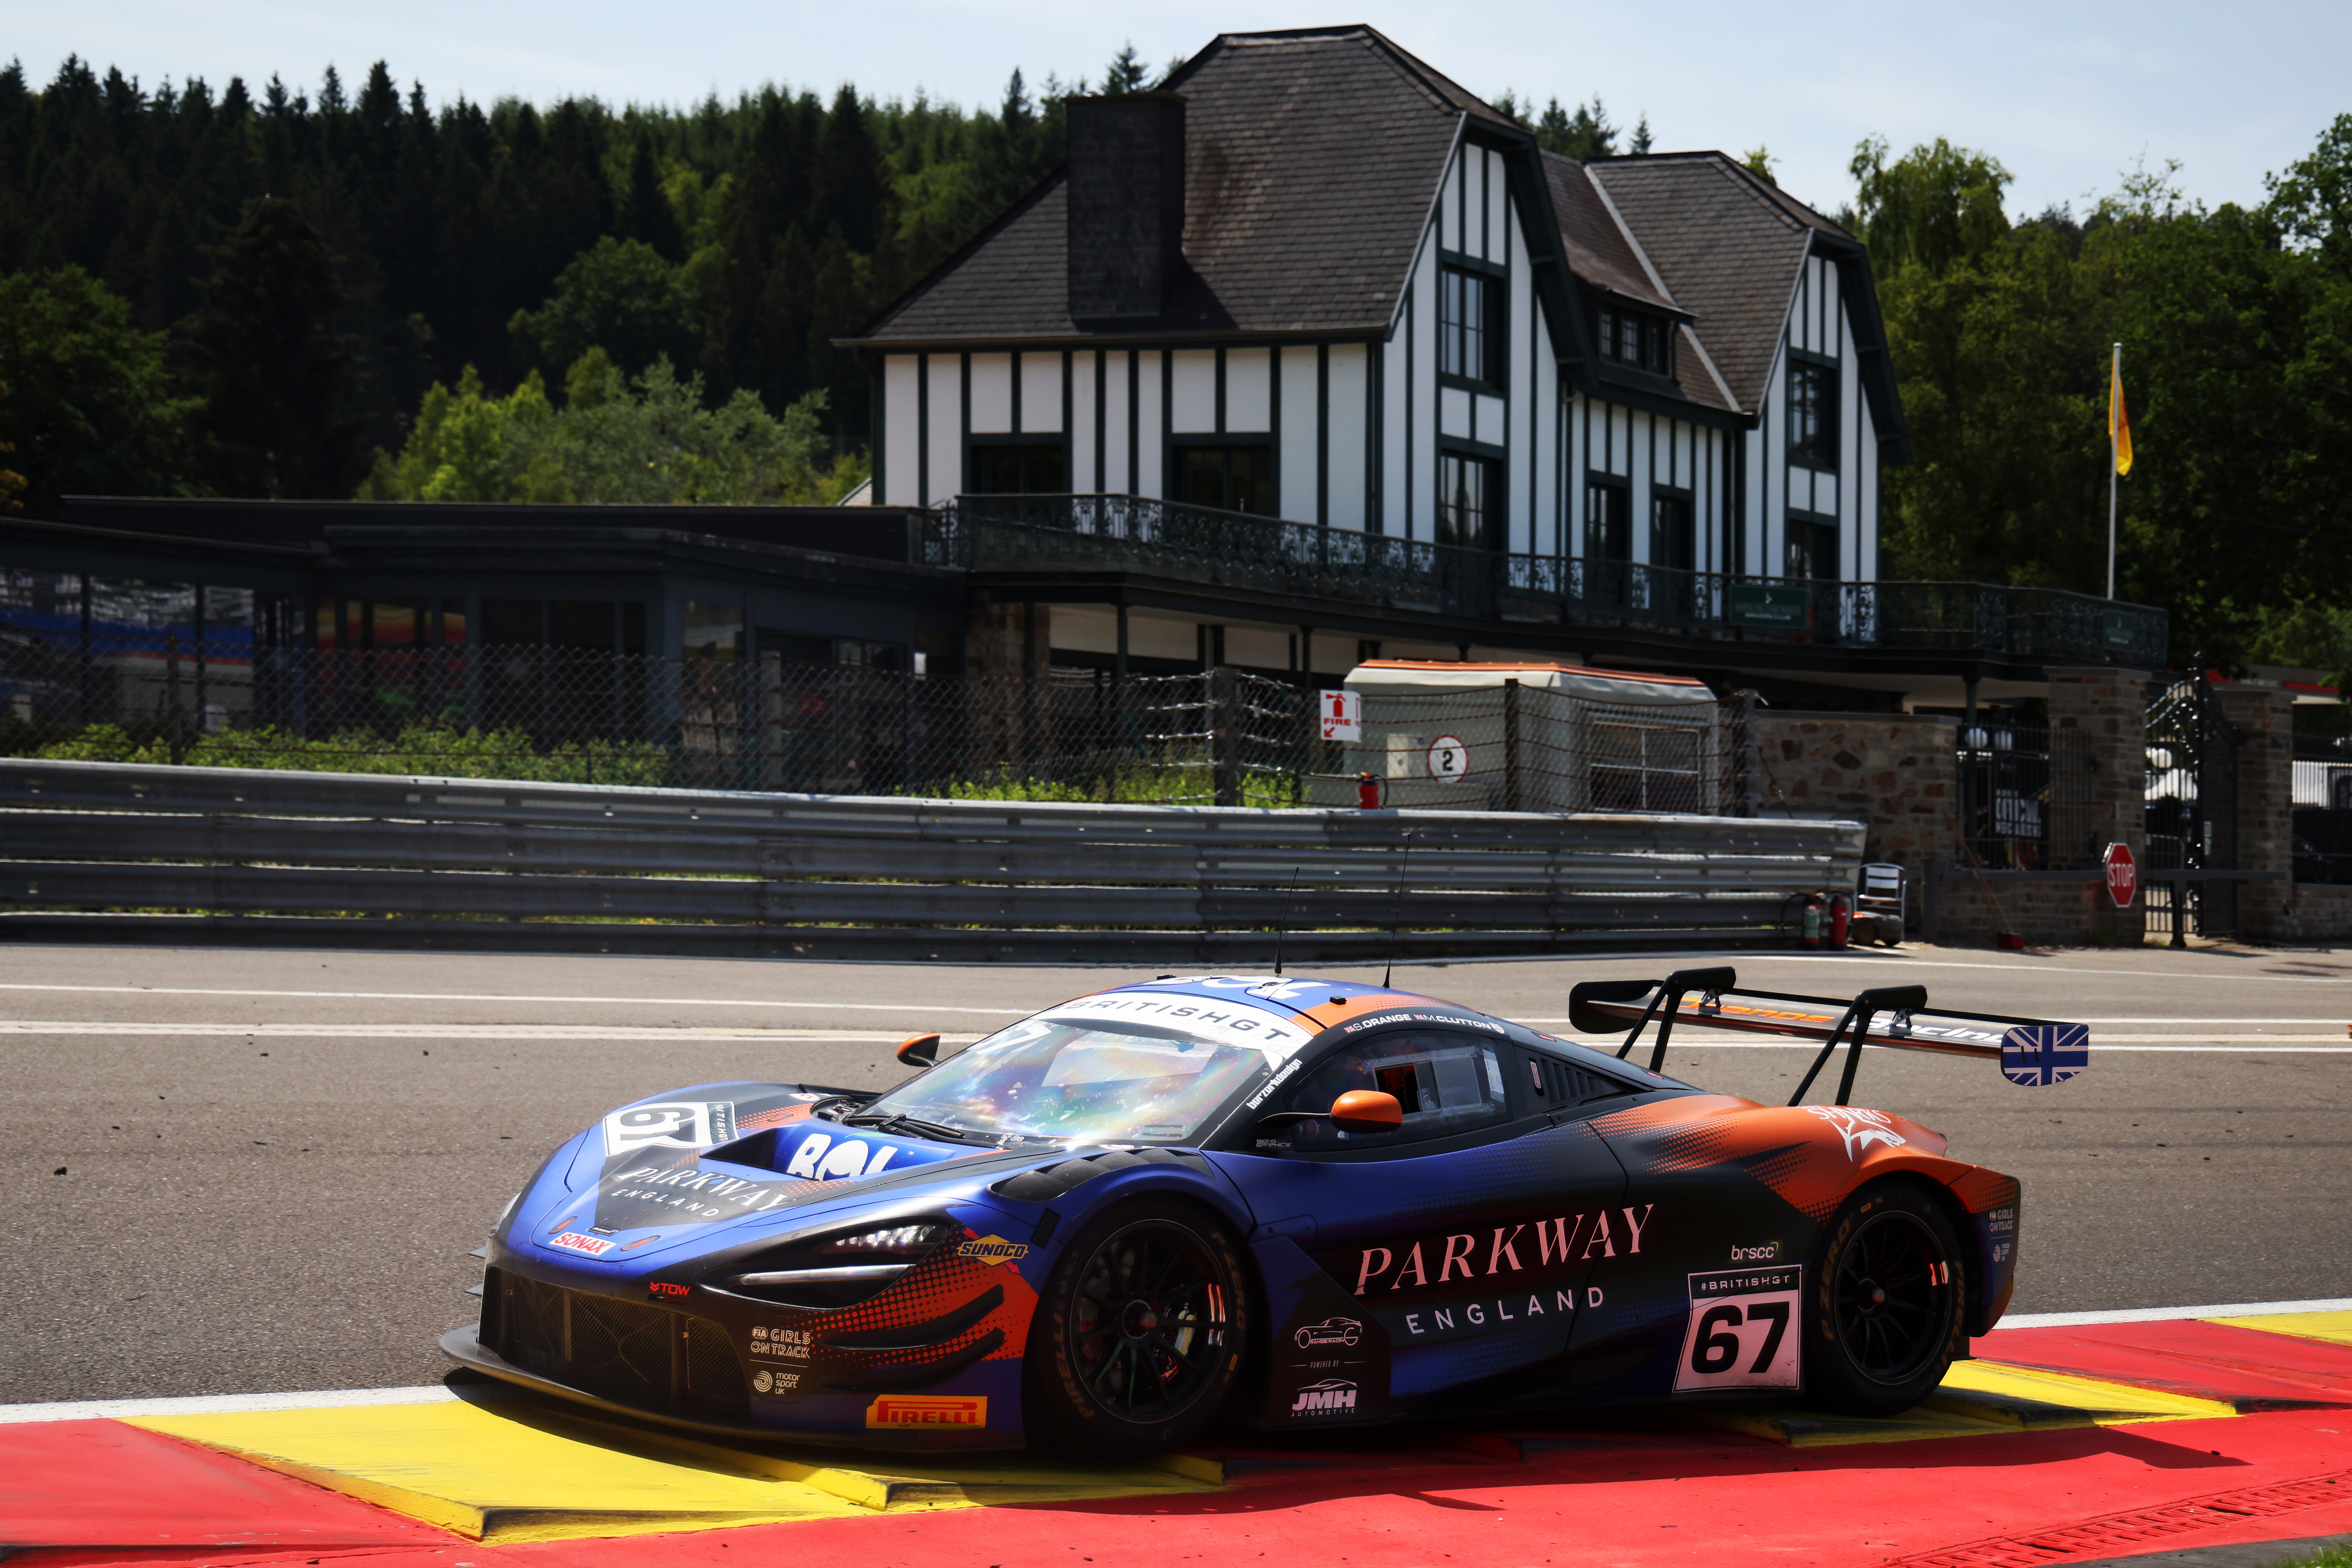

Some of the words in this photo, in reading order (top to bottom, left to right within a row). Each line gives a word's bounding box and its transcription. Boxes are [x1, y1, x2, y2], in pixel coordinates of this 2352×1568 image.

[1324, 717, 1351, 726] FIRE
[1443, 750, 1453, 771] 2
[2108, 862, 2135, 887] STOP
[1354, 1014, 1412, 1031] S.ORANGE
[1423, 1014, 1492, 1030] M.CLUTTON
[1531, 1063, 1541, 1087] PULL
[1807, 1107, 1891, 1124] SHARKS
[617, 1167, 791, 1211] PARKWAY
[611, 1189, 720, 1217] ENGLAND
[1997, 1209, 2013, 1220] GIRLS
[554, 1234, 612, 1254] SONAX
[960, 1242, 1027, 1258] SUNOCO
[1354, 1203, 1655, 1296] PARKWAY
[1731, 1245, 1774, 1260] brscc
[1820, 1218, 1851, 1311] ZERO
[661, 1282, 691, 1296] TOW
[1701, 1275, 1790, 1291] #BRITISHGT
[1406, 1287, 1604, 1334] ENGLAND
[771, 1328, 811, 1345] GIRLS
[1691, 1301, 1790, 1374] 67
[751, 1341, 770, 1354] ON
[771, 1343, 811, 1359] TRACK
[1054, 1313, 1095, 1419] PIRELLI
[776, 1372, 801, 1381] motor
[776, 1379, 797, 1388] sport
[1292, 1390, 1357, 1411] JMH
[877, 1400, 978, 1424] PIRELLI
[1292, 1408, 1355, 1417] AUTOMOTIVE
